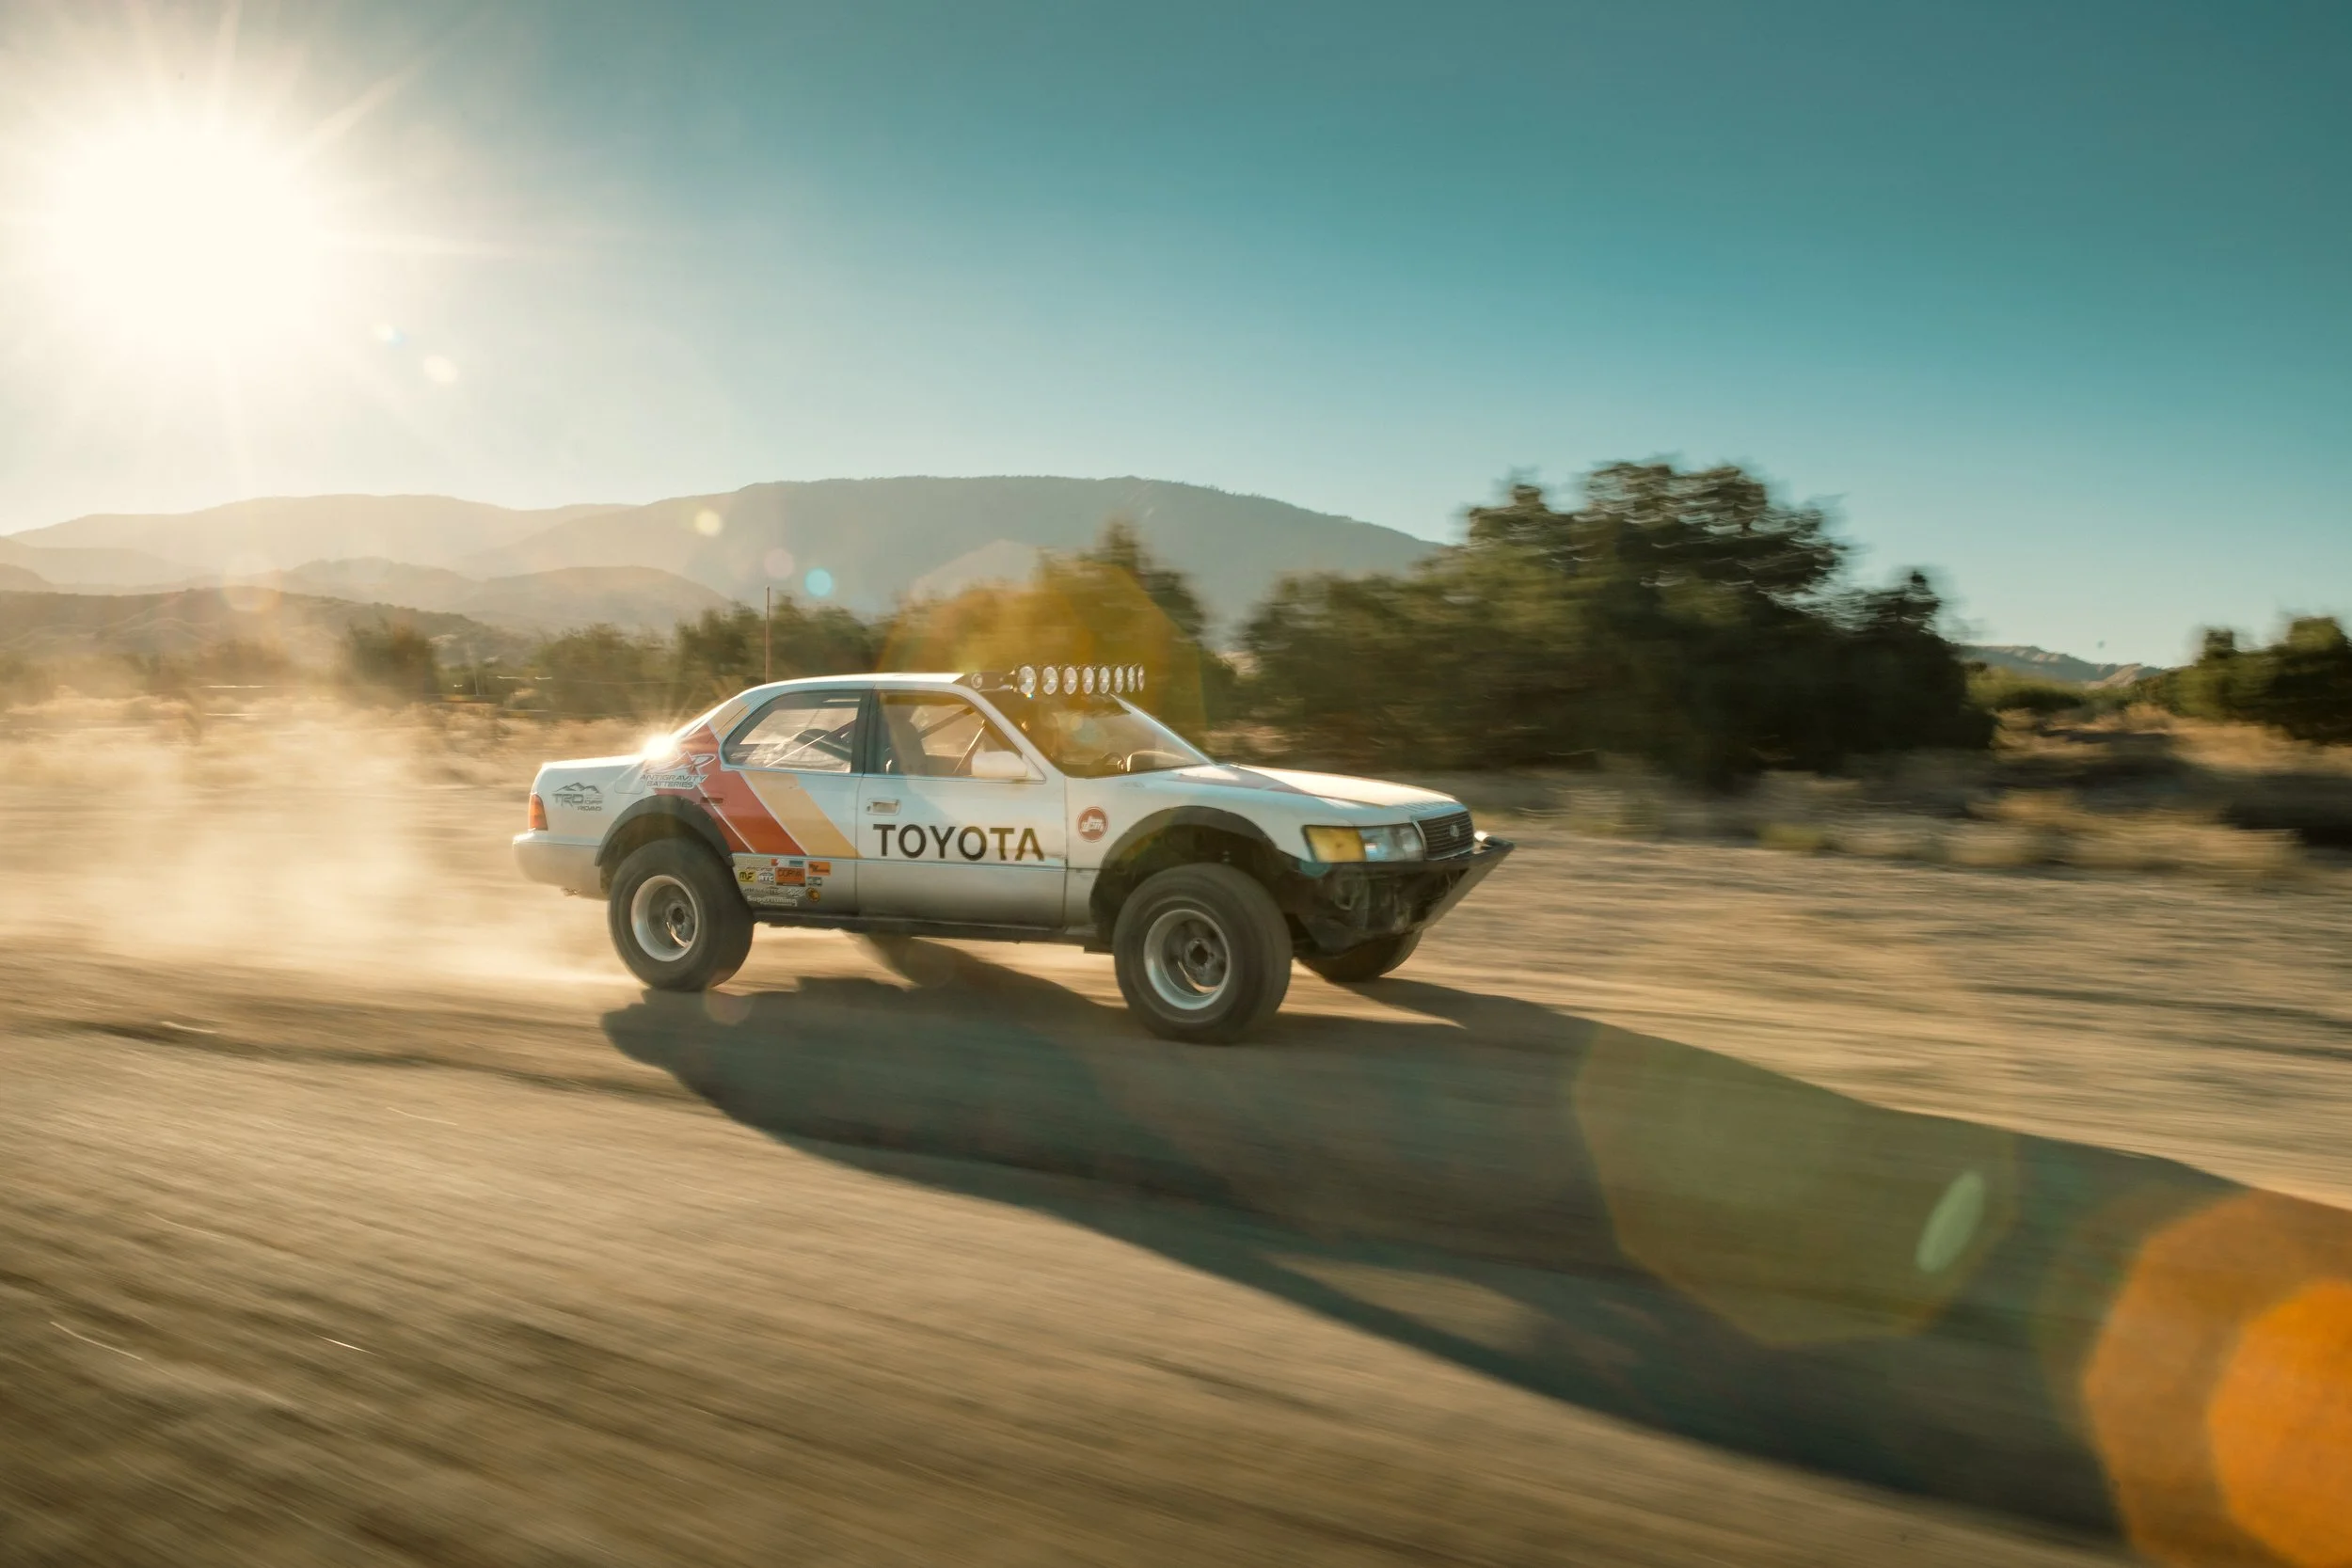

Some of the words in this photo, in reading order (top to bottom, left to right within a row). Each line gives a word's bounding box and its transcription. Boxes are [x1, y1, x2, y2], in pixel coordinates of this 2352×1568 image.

[645, 780, 693, 788] BATTERIES
[552, 793, 584, 807] TRD
[873, 823, 1045, 863] TOYOTA
